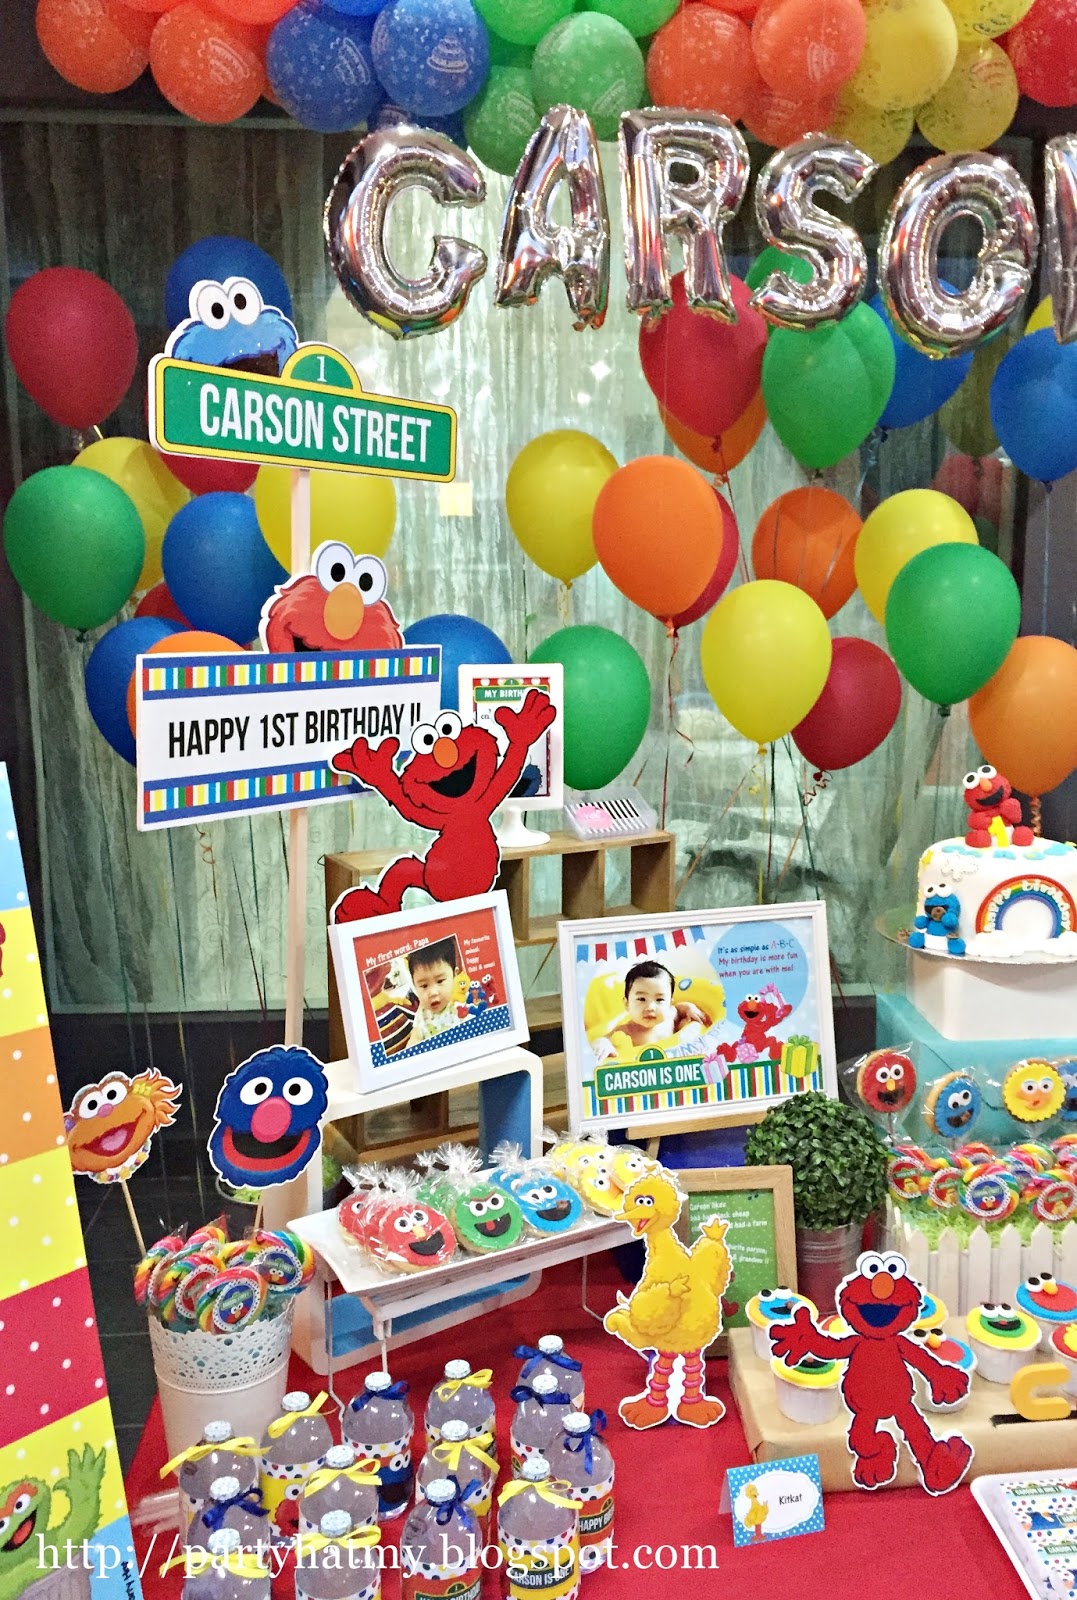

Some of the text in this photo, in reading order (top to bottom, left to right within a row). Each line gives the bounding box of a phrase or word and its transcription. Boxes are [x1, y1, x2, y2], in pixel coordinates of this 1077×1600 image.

[316, 355, 328, 383] 1
[200, 383, 432, 463] CARSON STREET
[484, 689, 522, 698] MY BIRTH
[168, 715, 250, 759] HAPPY
[260, 712, 299, 749] 1ST
[305, 703, 405, 744] BIRTHDAY
[365, 936, 430, 967] My first word: Papa
[740, 944, 760, 953] simple
[718, 957, 729, 966] My
[730, 955, 758, 965] birthday
[718, 970, 737, 978] when
[738, 970, 750, 979] you
[765, 965, 780, 973] with
[604, 1063, 701, 1091] CARSON IS ONE
[778, 1493, 802, 1505] Kitkat
[578, 1516, 603, 1532] HAPPY
[544, 1573, 553, 1585] IS
